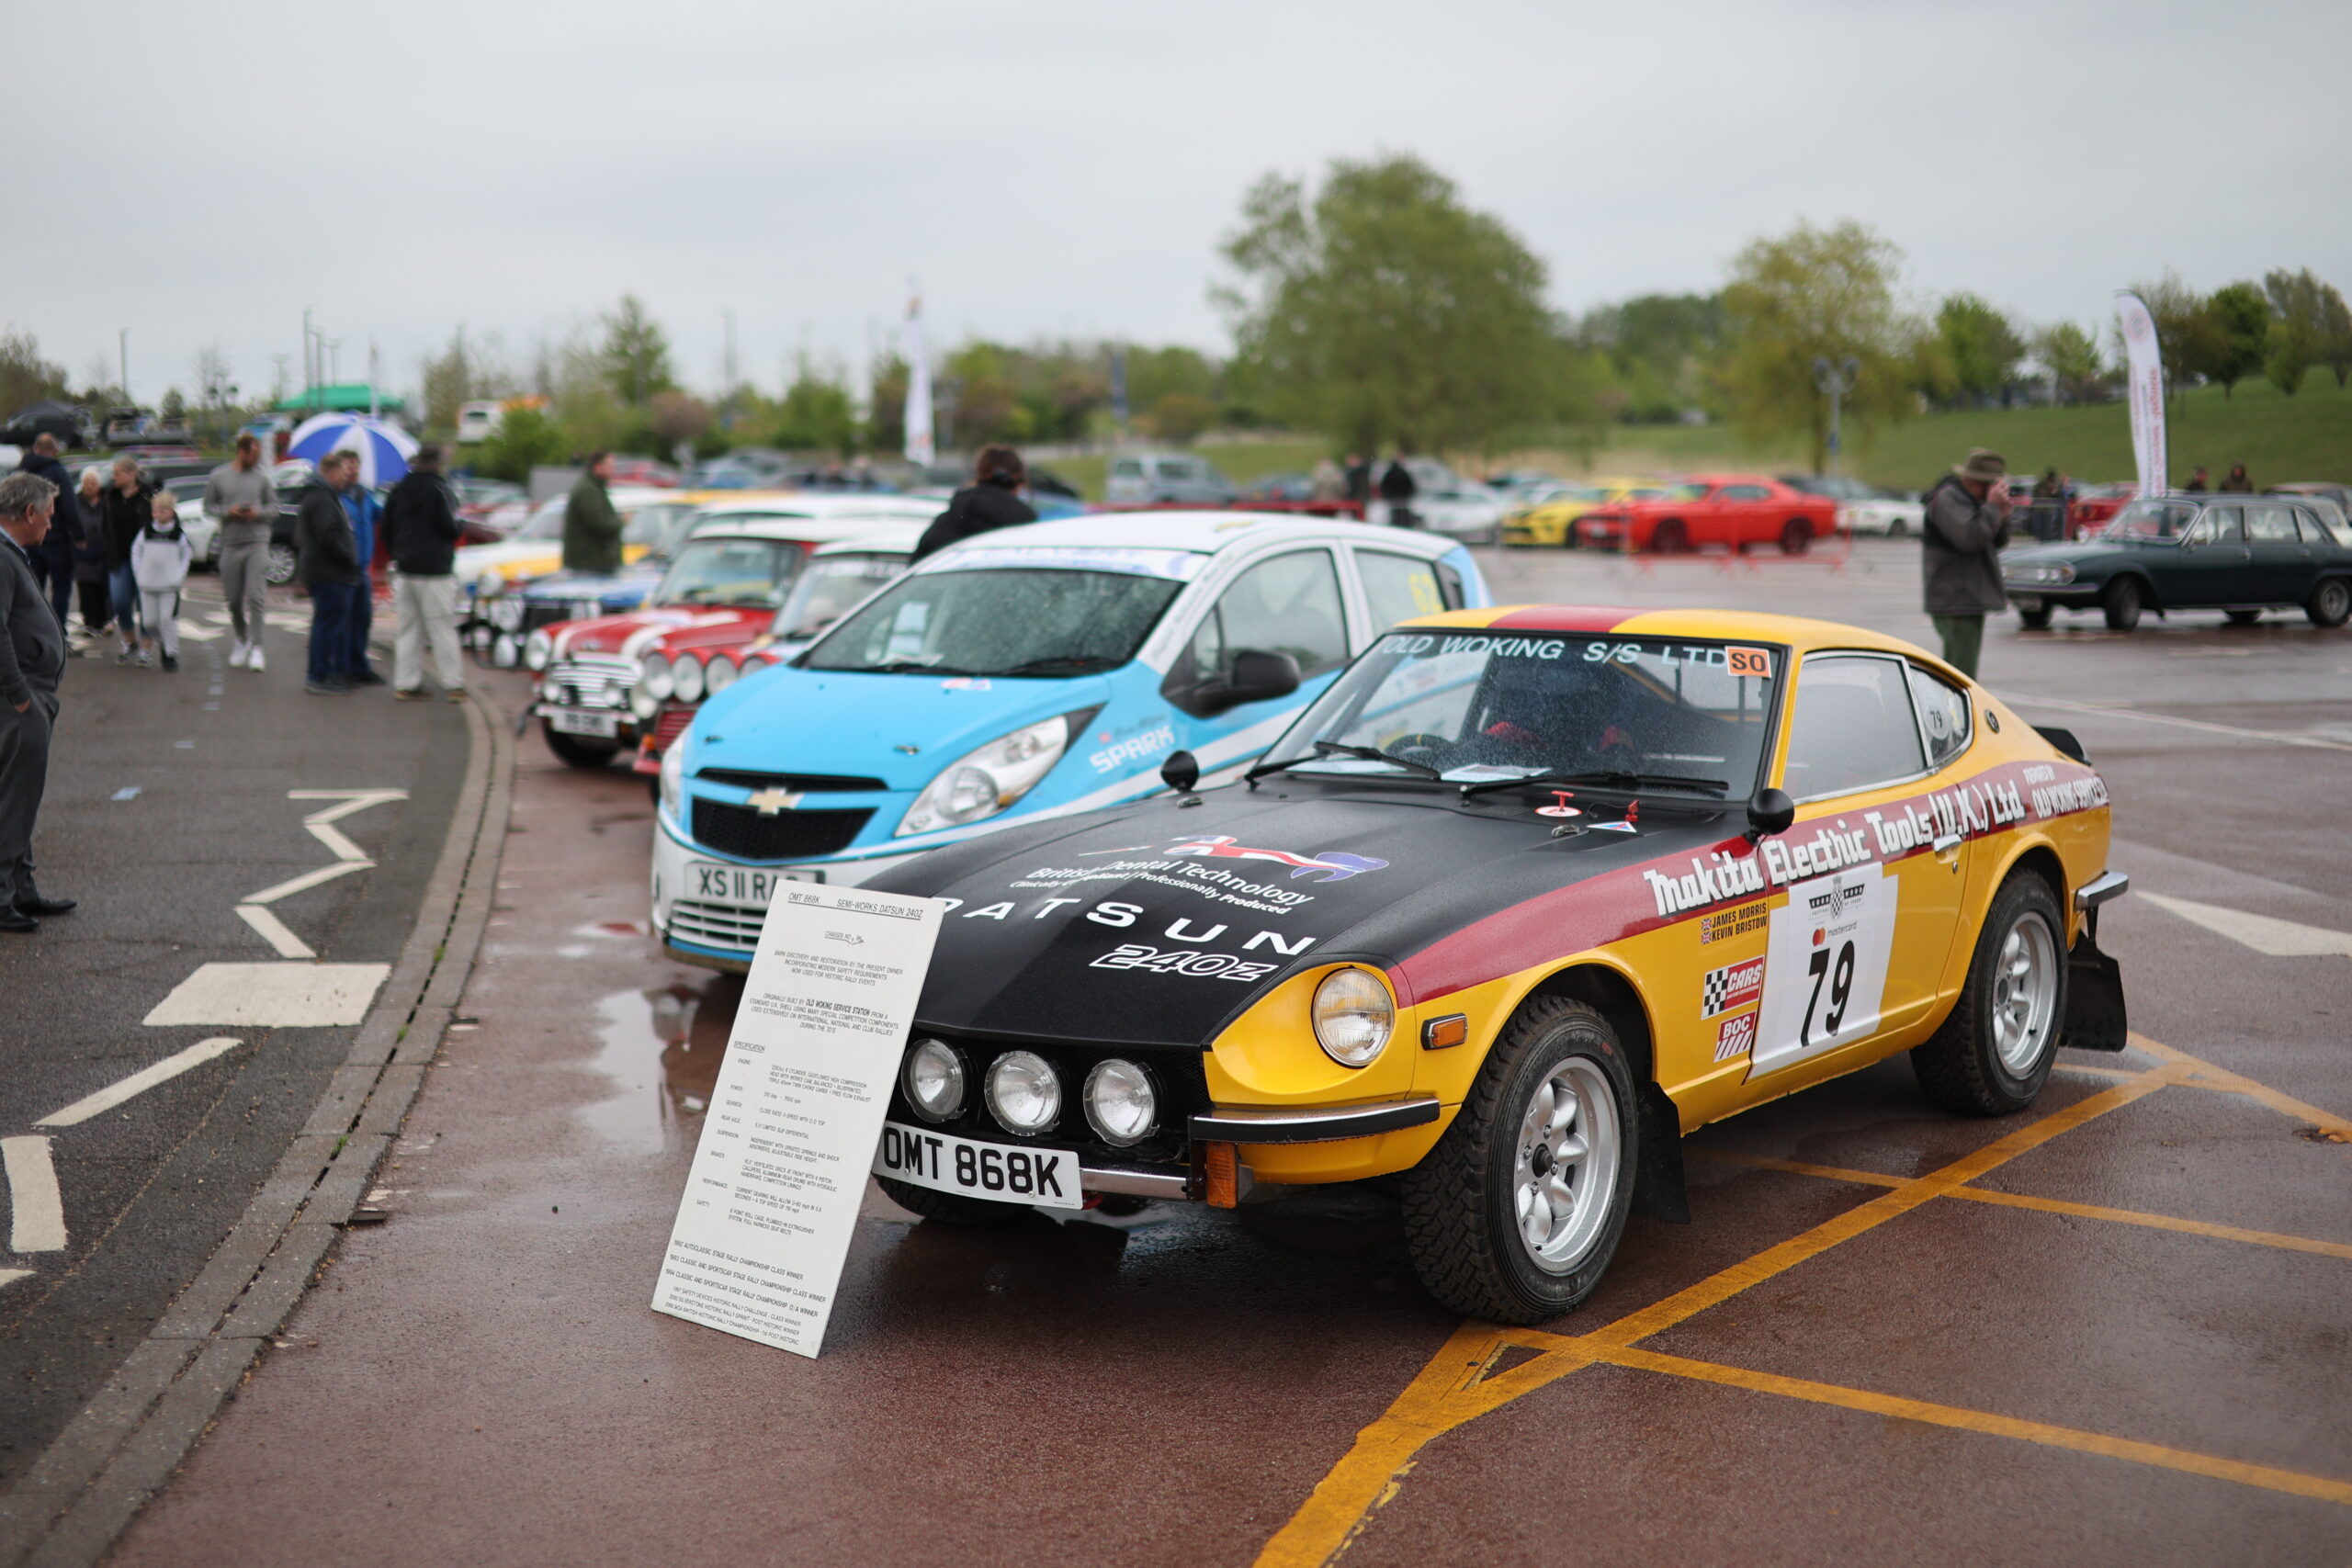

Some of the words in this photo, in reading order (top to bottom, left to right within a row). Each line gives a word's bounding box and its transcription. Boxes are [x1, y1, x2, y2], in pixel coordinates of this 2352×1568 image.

[1440, 637, 1565, 660] WOKING
[1582, 642, 1642, 664] S/S
[1661, 646, 1727, 668] LTD
[1930, 710, 1943, 729] 79
[1090, 725, 1175, 773] SPARK
[1763, 819, 1871, 886] Electric
[1864, 805, 1934, 854] Tools
[1026, 866, 1100, 879] British
[1177, 863, 1315, 906] Technology
[1136, 872, 1221, 899] Professionally
[1219, 894, 1292, 915] Produced
[803, 895, 821, 904] 868K
[836, 899, 878, 912] SEMI-WORKS
[878, 905, 905, 916] DATSUN
[906, 908, 923, 918] 240Z
[1713, 910, 1736, 928] JAMES
[1739, 903, 1766, 921] MORRIS
[1713, 923, 1733, 942] KEVIN
[1736, 916, 1767, 935] BRISTOW
[1827, 920, 1857, 937] mastercard
[785, 958, 817, 969] INCORPORATING
[818, 964, 836, 972] MODERN
[854, 970, 888, 981] REQUIREMENTS
[786, 952, 810, 961] DISCOVERY
[820, 957, 849, 966] RESTORATION
[865, 964, 887, 973] PRESENT
[886, 967, 903, 976] OWNER
[1089, 944, 1278, 982] 240Z
[1728, 964, 1762, 992] CARS
[824, 973, 844, 981] HISTORIC
[858, 978, 876, 987] EVENTS
[1801, 940, 1854, 1048] 79
[749, 998, 770, 1007] STANDARD
[820, 1010, 838, 1019] SPECIAL
[838, 1013, 867, 1024] COMPETITION
[867, 1019, 899, 1030] COMPONENTS
[763, 993, 786, 1002] ORIGINALLY
[815, 1000, 832, 1010] WOKING
[832, 1004, 852, 1013] SERVICE
[852, 1007, 871, 1016] STATION
[763, 1008, 789, 1018] EXTENSIVELY
[830, 1020, 852, 1029] NATIONAL
[862, 1025, 875, 1033] CLUB
[875, 1028, 894, 1037] RALLIES
[799, 1021, 817, 1030] DURING
[1724, 1016, 1750, 1037] BOC
[733, 1041, 765, 1053] SPECIFICATION
[883, 1126, 944, 1180] OMT
[955, 1145, 1063, 1198] 868K
[684, 1242, 712, 1255] AUTOCLASSIC
[712, 1250, 726, 1258] STAGE
[726, 1254, 739, 1262] RALLY
[739, 1258, 771, 1271] CHAMPIONSHIP
[771, 1267, 786, 1276] CLASS
[786, 1270, 804, 1280] WINNER
[675, 1271, 694, 1280] CLASSIC
[704, 1280, 728, 1292] SPORTSCAR
[729, 1287, 742, 1295] STAGE
[742, 1291, 755, 1299] RALLY
[755, 1294, 788, 1309] CHAMPIONSHIP
[799, 1307, 819, 1317] WINNER
[679, 1257, 697, 1267] CLASSIC
[707, 1265, 732, 1277] SPORTSCAR
[733, 1272, 747, 1280] STAGE
[747, 1276, 760, 1284] RALLY
[760, 1280, 792, 1293] CHAMPIONSHIP
[792, 1289, 808, 1298] CLASS
[808, 1293, 826, 1303] WINNER
[682, 1289, 696, 1297] SAFETY
[696, 1292, 713, 1302] DEVICES
[713, 1297, 731, 1307] HISTORIC
[731, 1303, 744, 1311] RALLY
[744, 1306, 768, 1317] CHALLENGE
[770, 1314, 785, 1322] CLASS
[785, 1318, 801, 1327] WINNER
[704, 1303, 722, 1314] HISTORIC
[722, 1309, 735, 1317] RALLY
[735, 1313, 750, 1322] SPRINT
[752, 1317, 763, 1325] POST
[763, 1321, 784, 1332] HISTORIC
[783, 1326, 800, 1337] WINNER
[698, 1312, 718, 1321] HISTORIC
[729, 1320, 760, 1334] CHAMPIONSHIP
[768, 1332, 779, 1340] POST
[779, 1336, 799, 1346] HISTORIC
